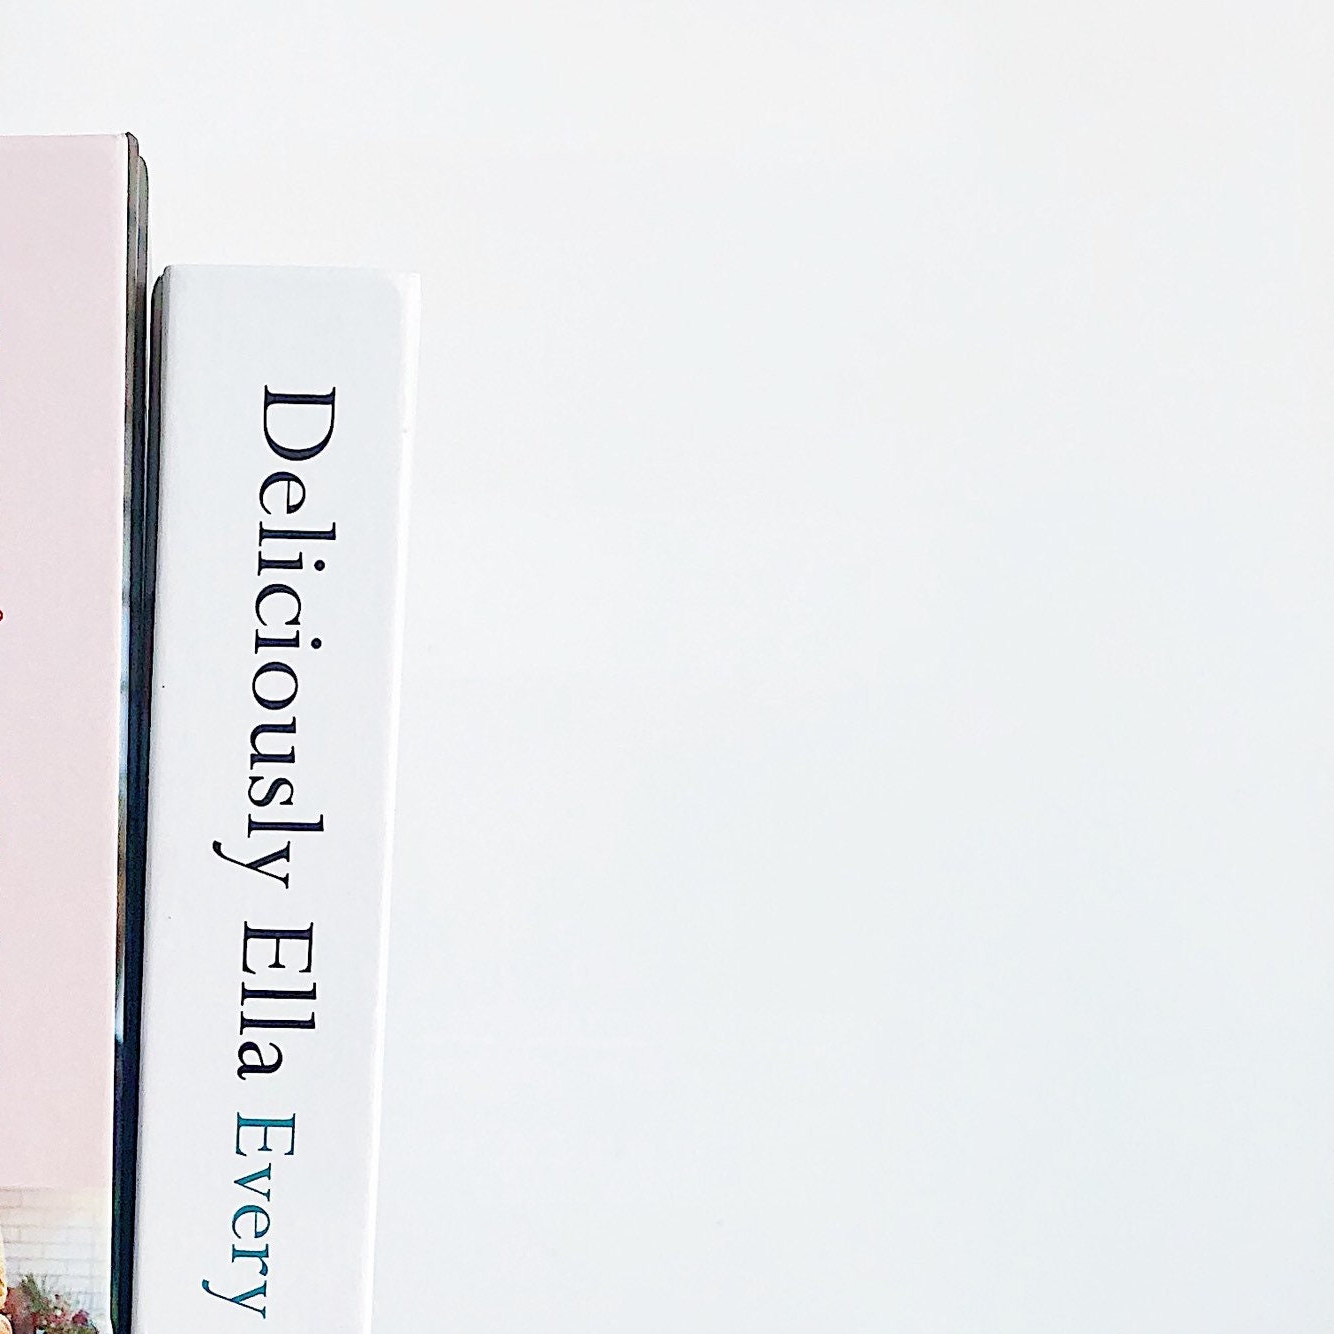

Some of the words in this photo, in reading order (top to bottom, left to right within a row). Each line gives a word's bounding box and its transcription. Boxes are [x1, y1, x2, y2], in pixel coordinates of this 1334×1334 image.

[211, 384, 337, 890] Deliciously
[236, 920, 318, 1081] Ella
[201, 1111, 297, 1320] Every
